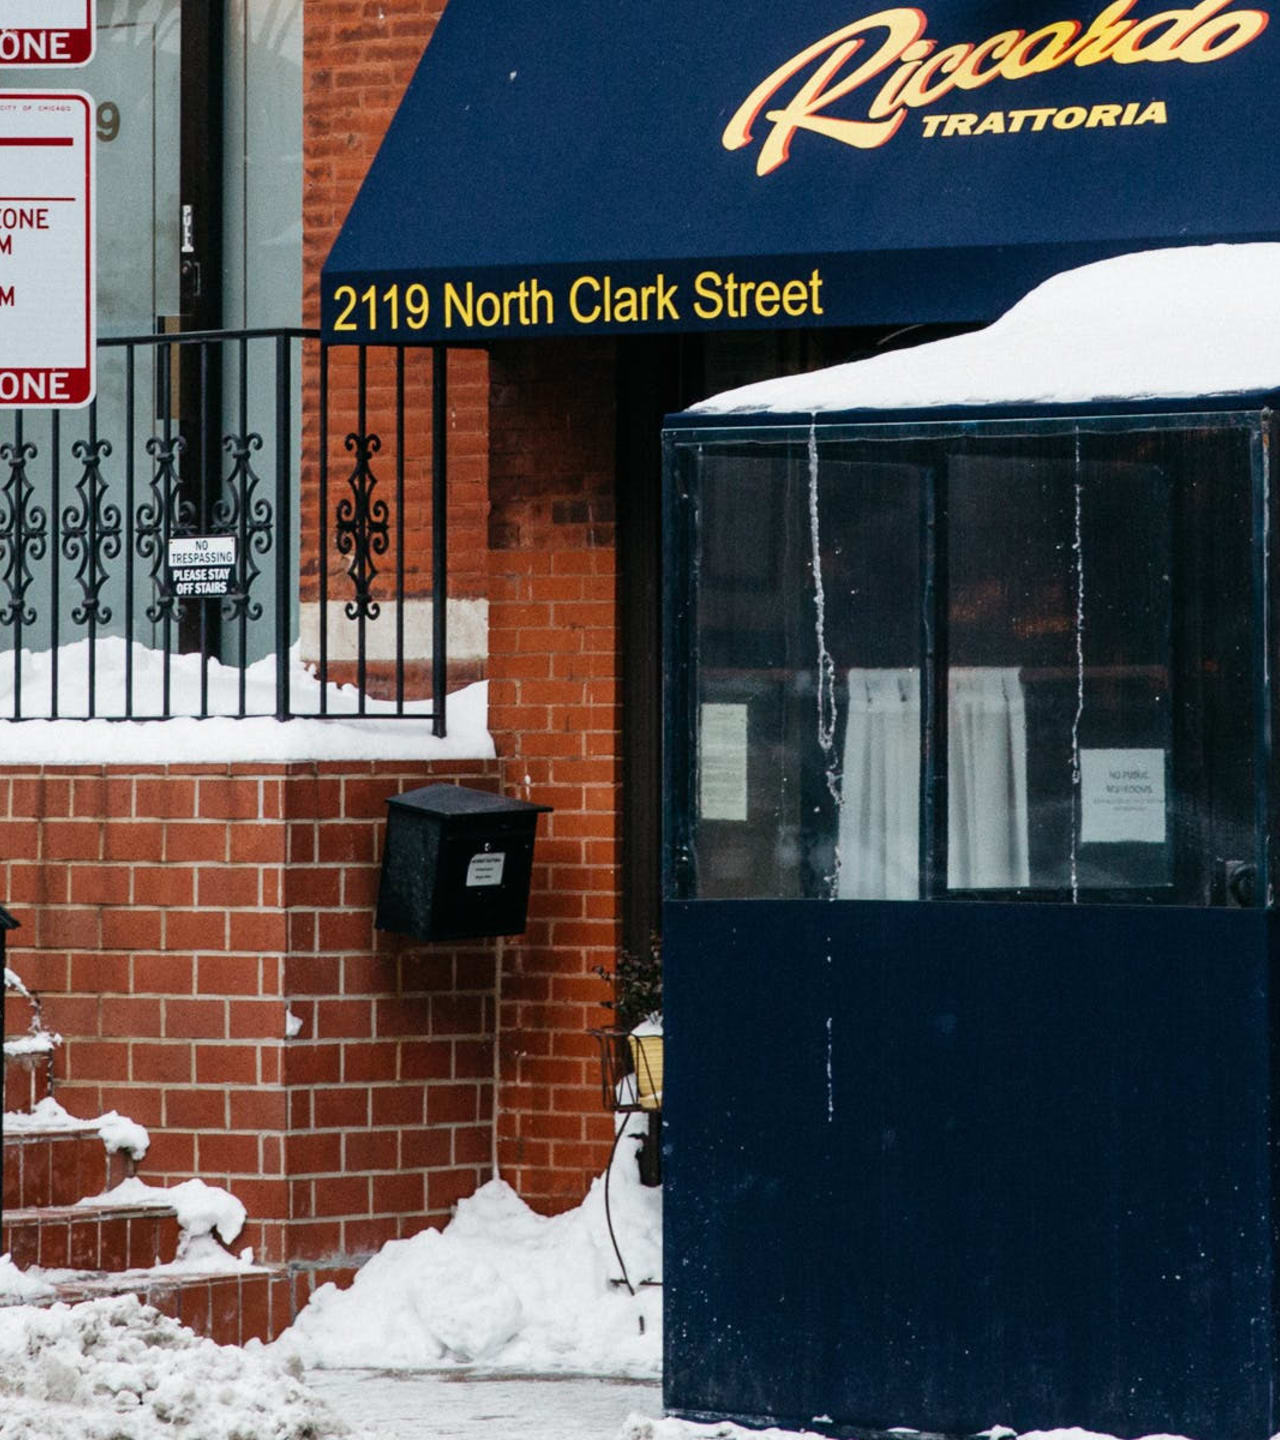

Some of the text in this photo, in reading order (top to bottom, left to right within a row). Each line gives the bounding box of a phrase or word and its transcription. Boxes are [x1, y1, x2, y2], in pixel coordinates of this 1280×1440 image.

[921, 101, 1168, 138] TRATTORIA
[333, 269, 824, 332] 2119 North Clark Street
[195, 540, 208, 550] NO
[172, 552, 233, 564] TRESPASSING
[173, 568, 231, 581] PLEASE STAY
[176, 582, 227, 595] OFF STAIRS
